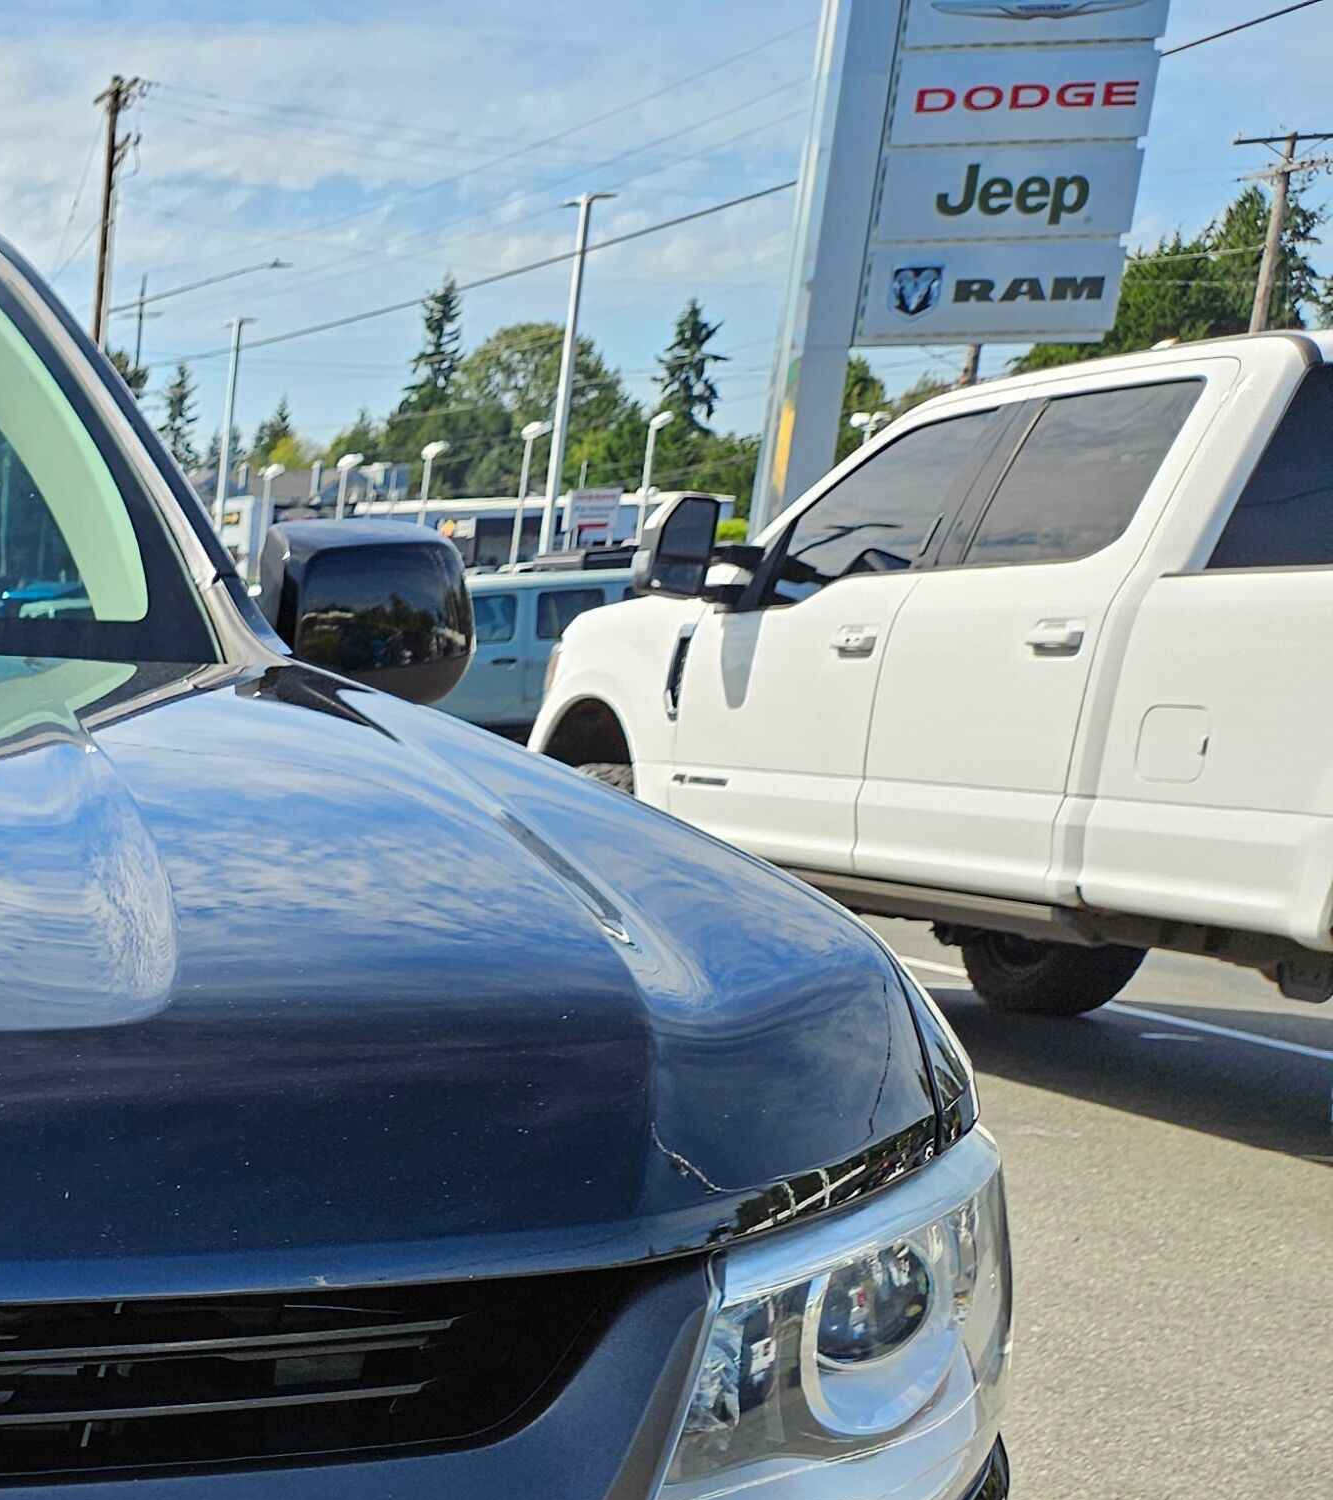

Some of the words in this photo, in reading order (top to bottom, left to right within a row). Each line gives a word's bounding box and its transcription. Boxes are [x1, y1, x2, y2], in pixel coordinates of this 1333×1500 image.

[915, 80, 1140, 114] DODGE
[936, 163, 1090, 225] Jeep
[952, 276, 1106, 303] RAM
